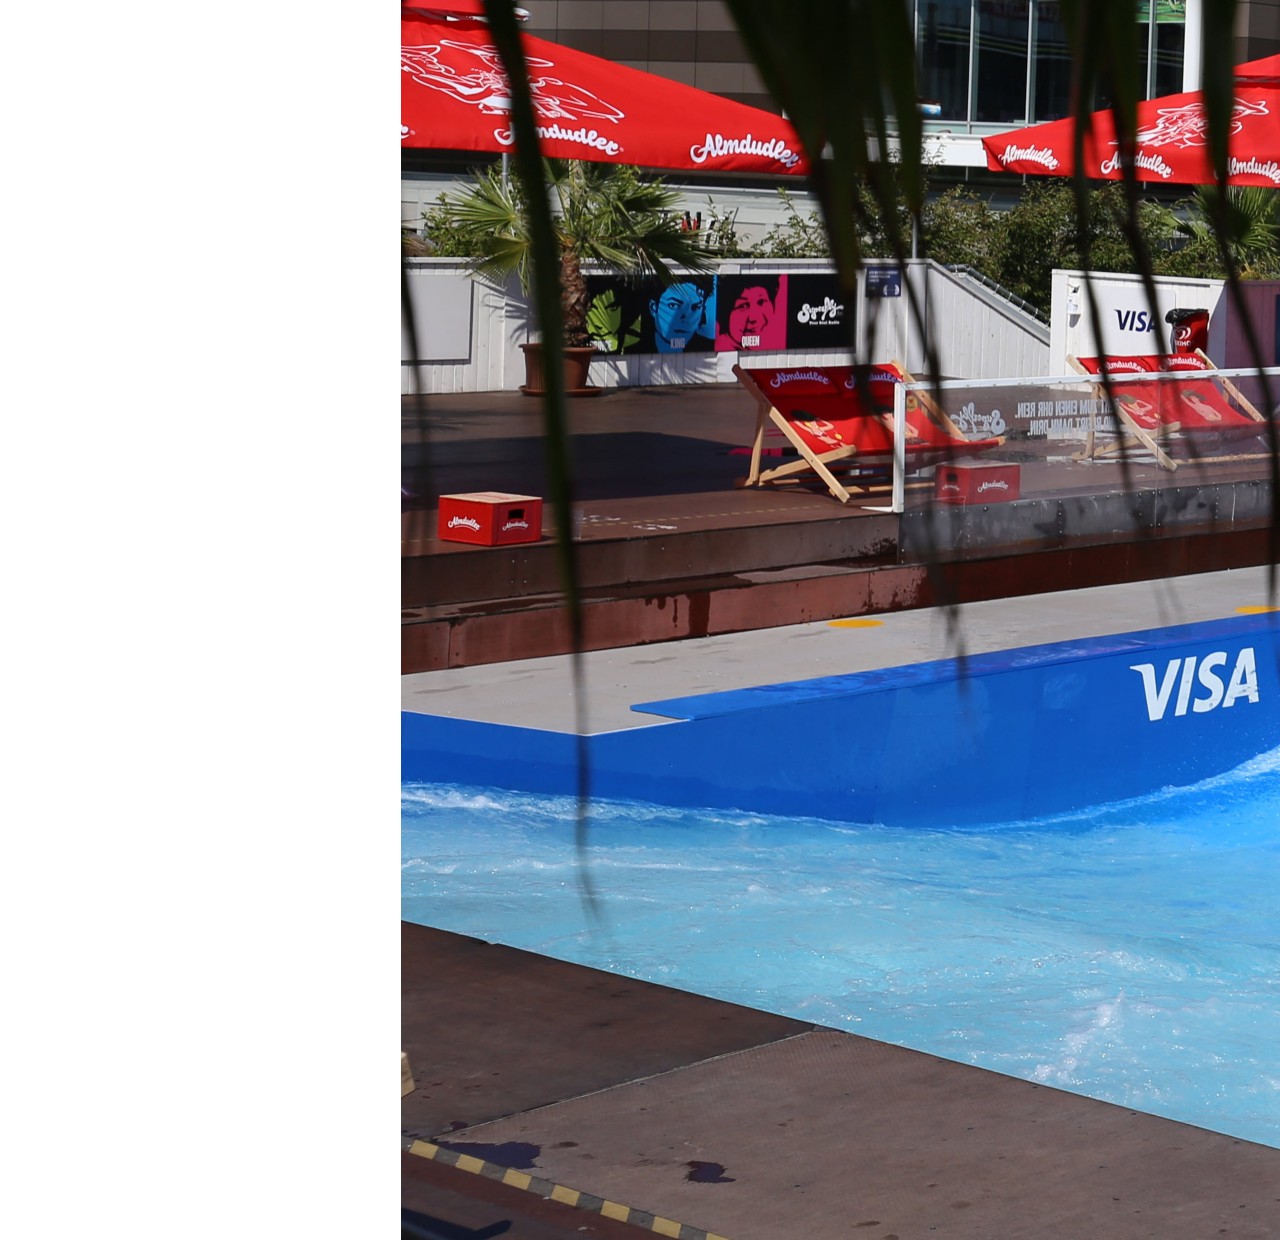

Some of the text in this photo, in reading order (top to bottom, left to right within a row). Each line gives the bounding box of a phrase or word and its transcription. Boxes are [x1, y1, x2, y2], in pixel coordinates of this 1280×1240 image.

[690, 133, 799, 167] Almdudler
[998, 144, 1059, 171] Almdudler
[670, 338, 686, 348] KING
[741, 335, 760, 348] QUEEN
[770, 371, 829, 388] Almdudler
[448, 516, 480, 531] Almdudler
[502, 521, 529, 531] Almdudler
[1129, 647, 1260, 721] VISA
